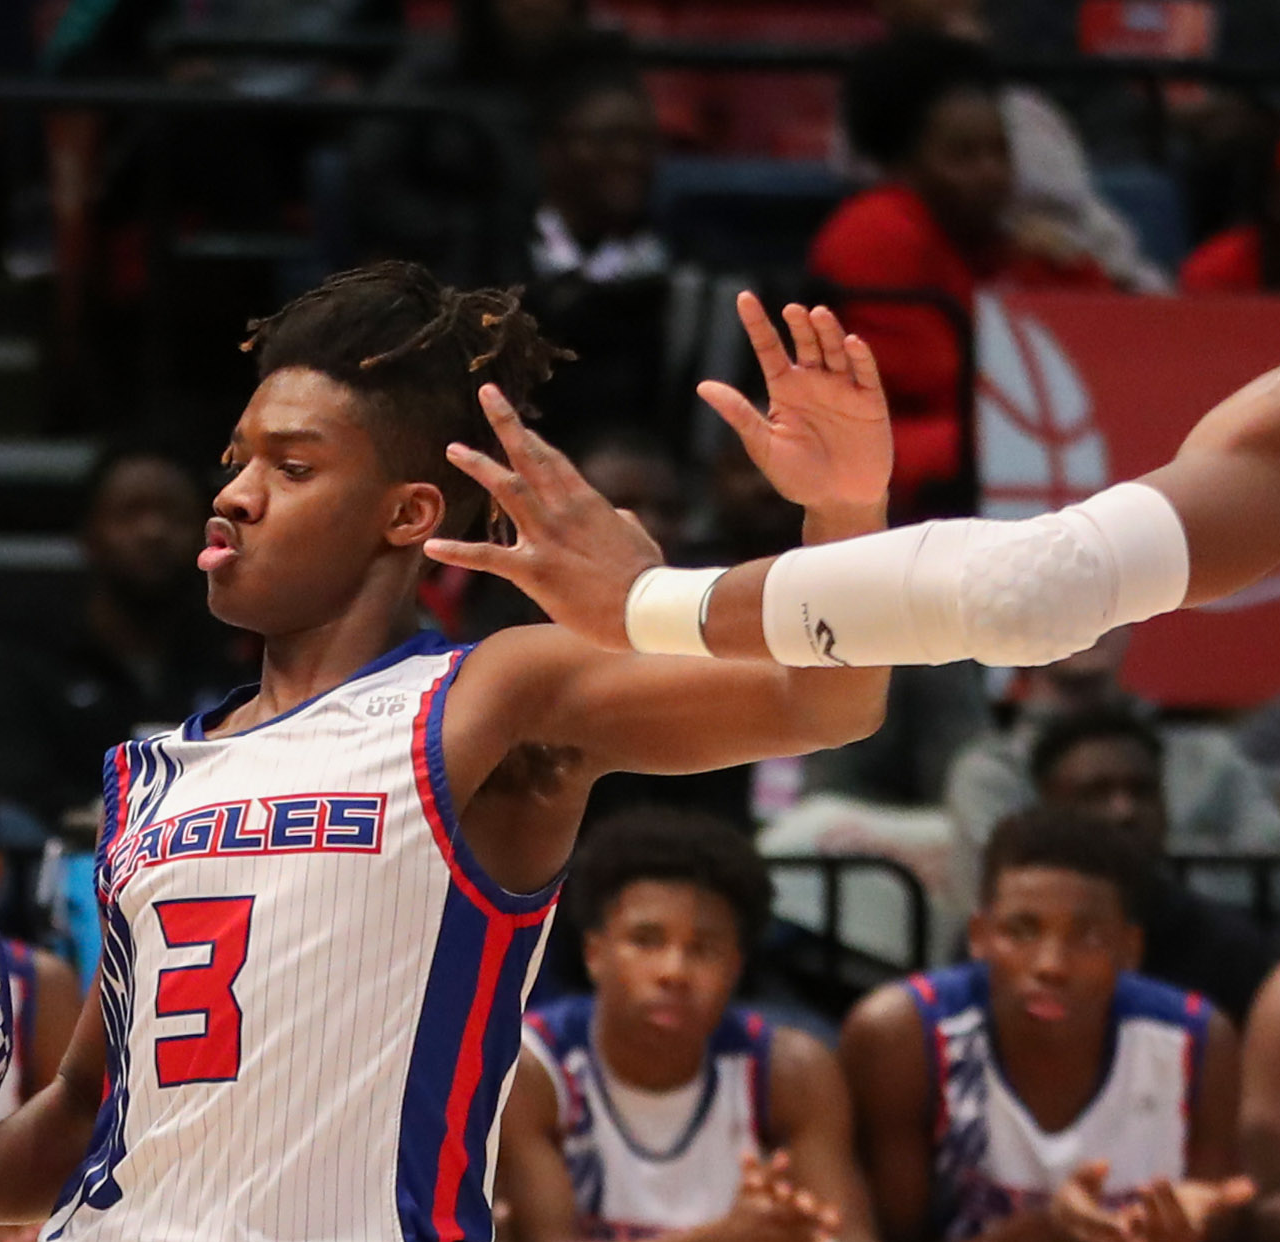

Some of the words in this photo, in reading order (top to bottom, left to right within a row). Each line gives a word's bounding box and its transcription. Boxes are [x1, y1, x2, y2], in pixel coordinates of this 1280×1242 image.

[365, 702, 407, 718] UP
[368, 693, 408, 704] LEVEL
[110, 793, 388, 879] EAGLES
[152, 895, 257, 1089] 3
